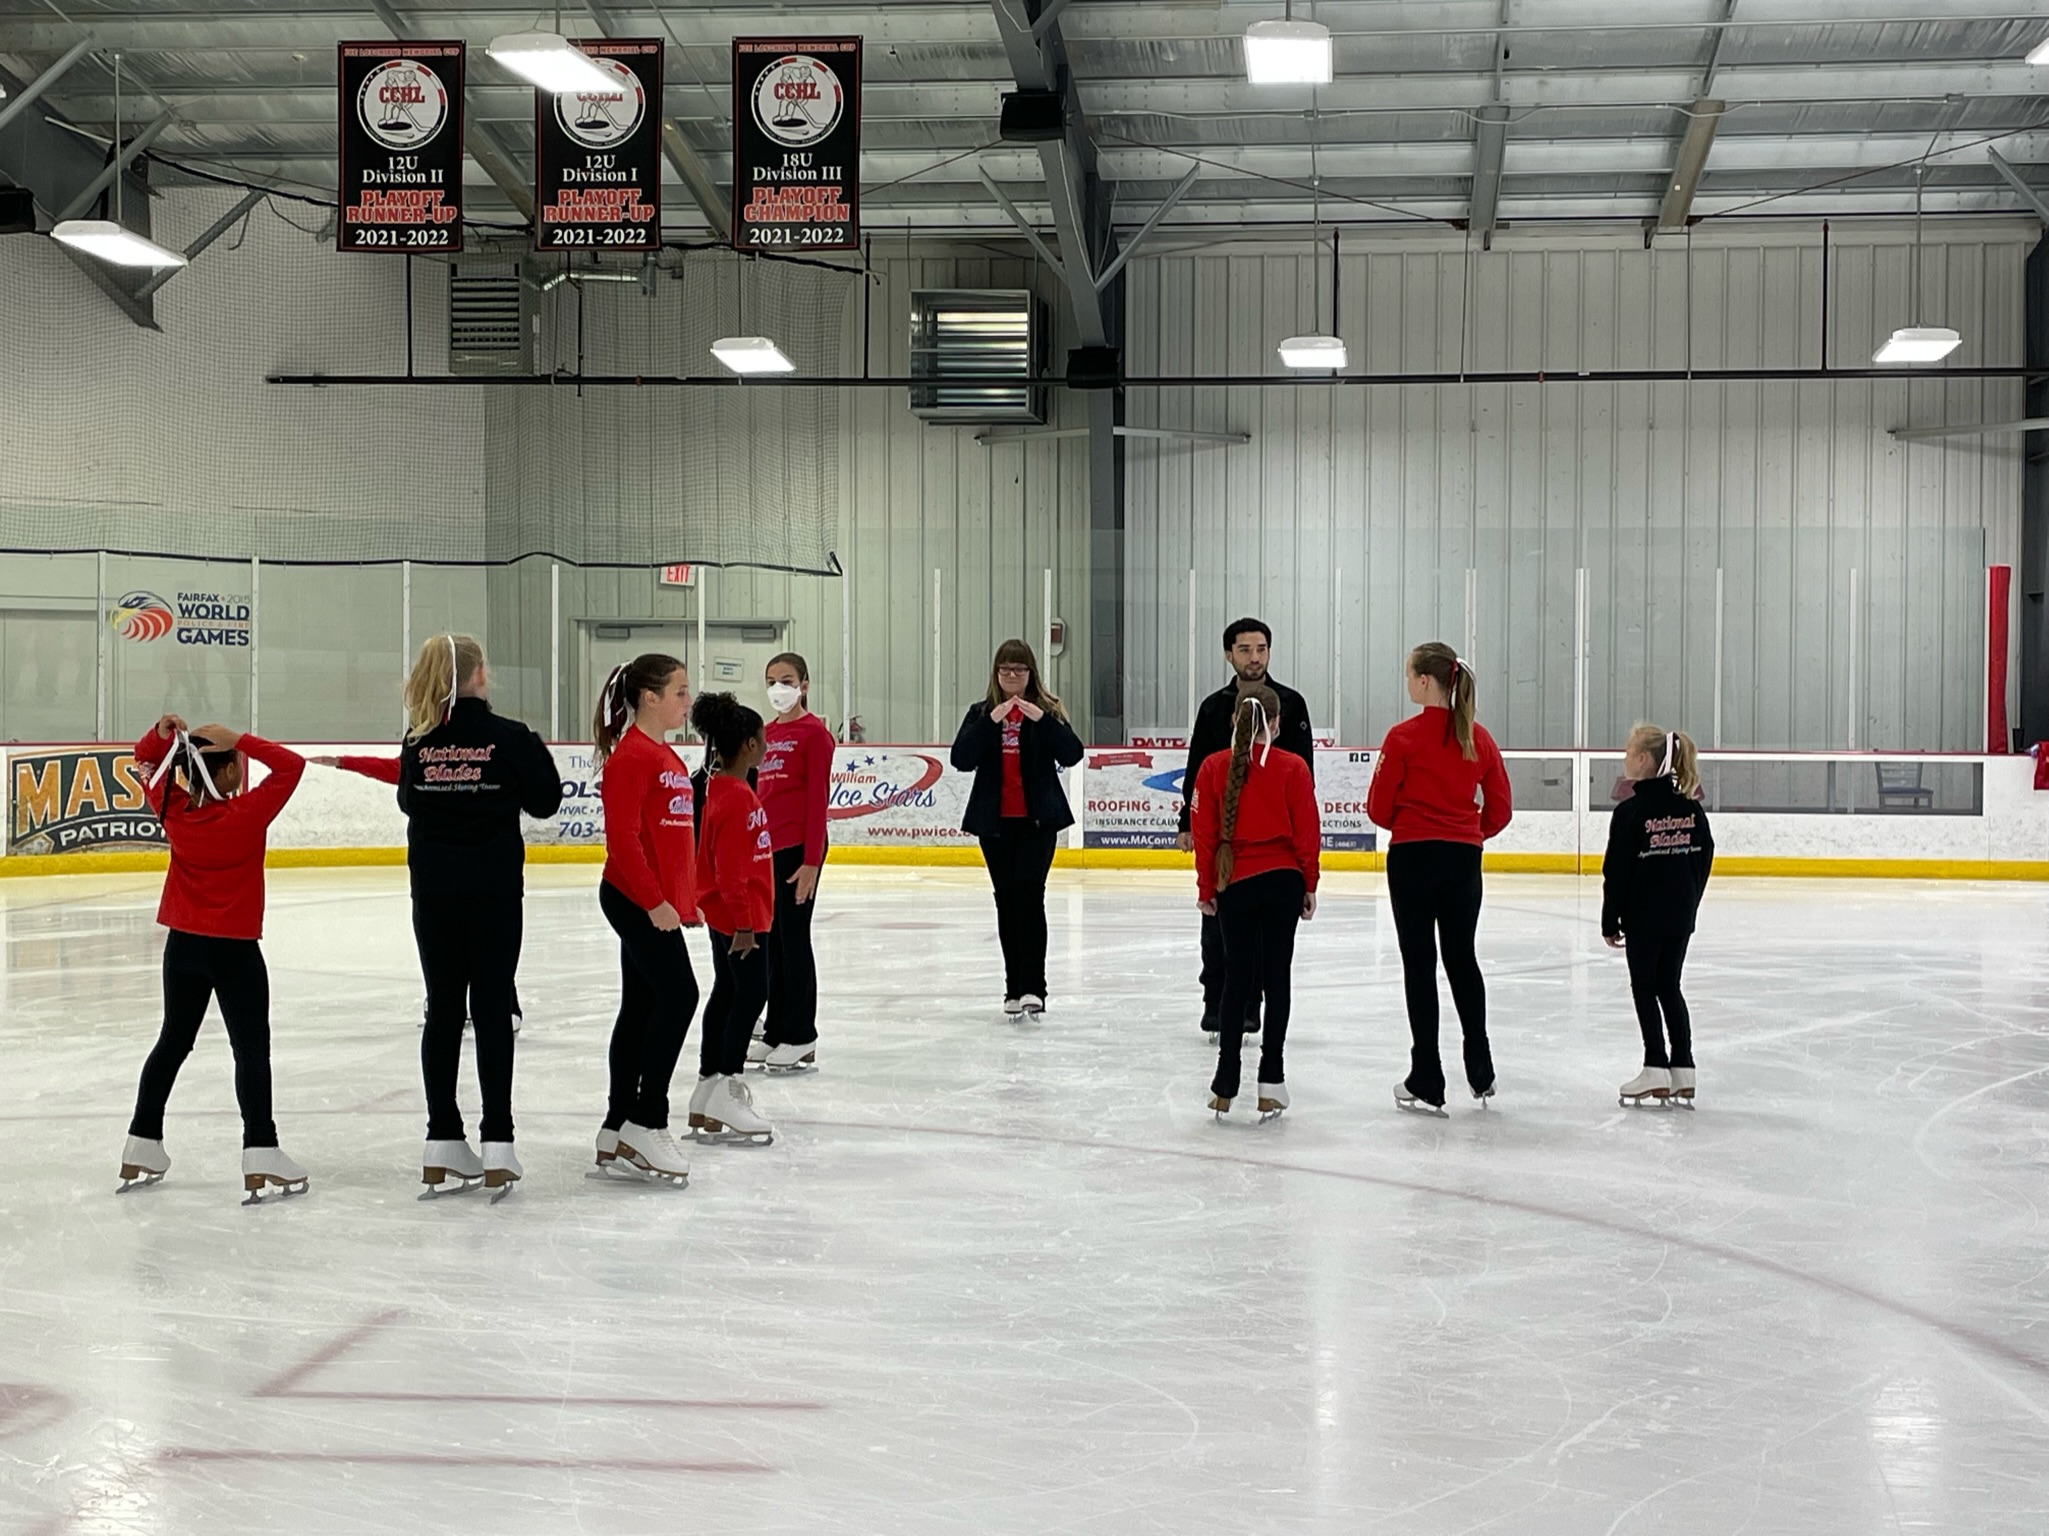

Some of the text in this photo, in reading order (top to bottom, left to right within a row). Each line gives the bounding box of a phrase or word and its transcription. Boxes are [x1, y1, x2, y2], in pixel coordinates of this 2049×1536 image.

[641, 45, 658, 54] CUP
[379, 86, 425, 103] CCHL
[774, 83, 821, 100] CCHL
[388, 156, 418, 170] 12U
[585, 154, 616, 169] 12U
[782, 152, 813, 167] 18U
[362, 169, 443, 183] Division II
[562, 167, 638, 182] Division I
[752, 166, 842, 181] Division III
[361, 190, 445, 206] PLAYOFF
[558, 188, 643, 206] PLAYOFF
[752, 186, 843, 205] PLAYOFF
[346, 206, 457, 224] RUNNER-UP
[543, 205, 655, 223] RUNNER-UP
[744, 203, 850, 222] CHAMPION
[355, 229, 448, 246] 2021-2022
[552, 228, 647, 244] 2021-2022
[749, 227, 844, 244] 2021-2022
[666, 564, 690, 582] EXIT
[177, 592, 250, 605] FAIRFAX 2015
[178, 603, 250, 620] WORLD
[177, 628, 249, 646] GAMES
[419, 744, 496, 763] National
[423, 763, 482, 782] Blades
[831, 772, 877, 784] William
[16, 755, 147, 840] MAS
[830, 781, 937, 809] Ice Stars
[1088, 800, 1151, 812] ROOFING
[1095, 818, 1180, 827] INSURANCE CLAIM
[1322, 820, 1362, 828] ECTIONS
[1645, 813, 1696, 833] National
[867, 825, 971, 838] www.pwice.c
[1100, 835, 1177, 845] www.MAContr
[1649, 831, 1691, 848] Blades
